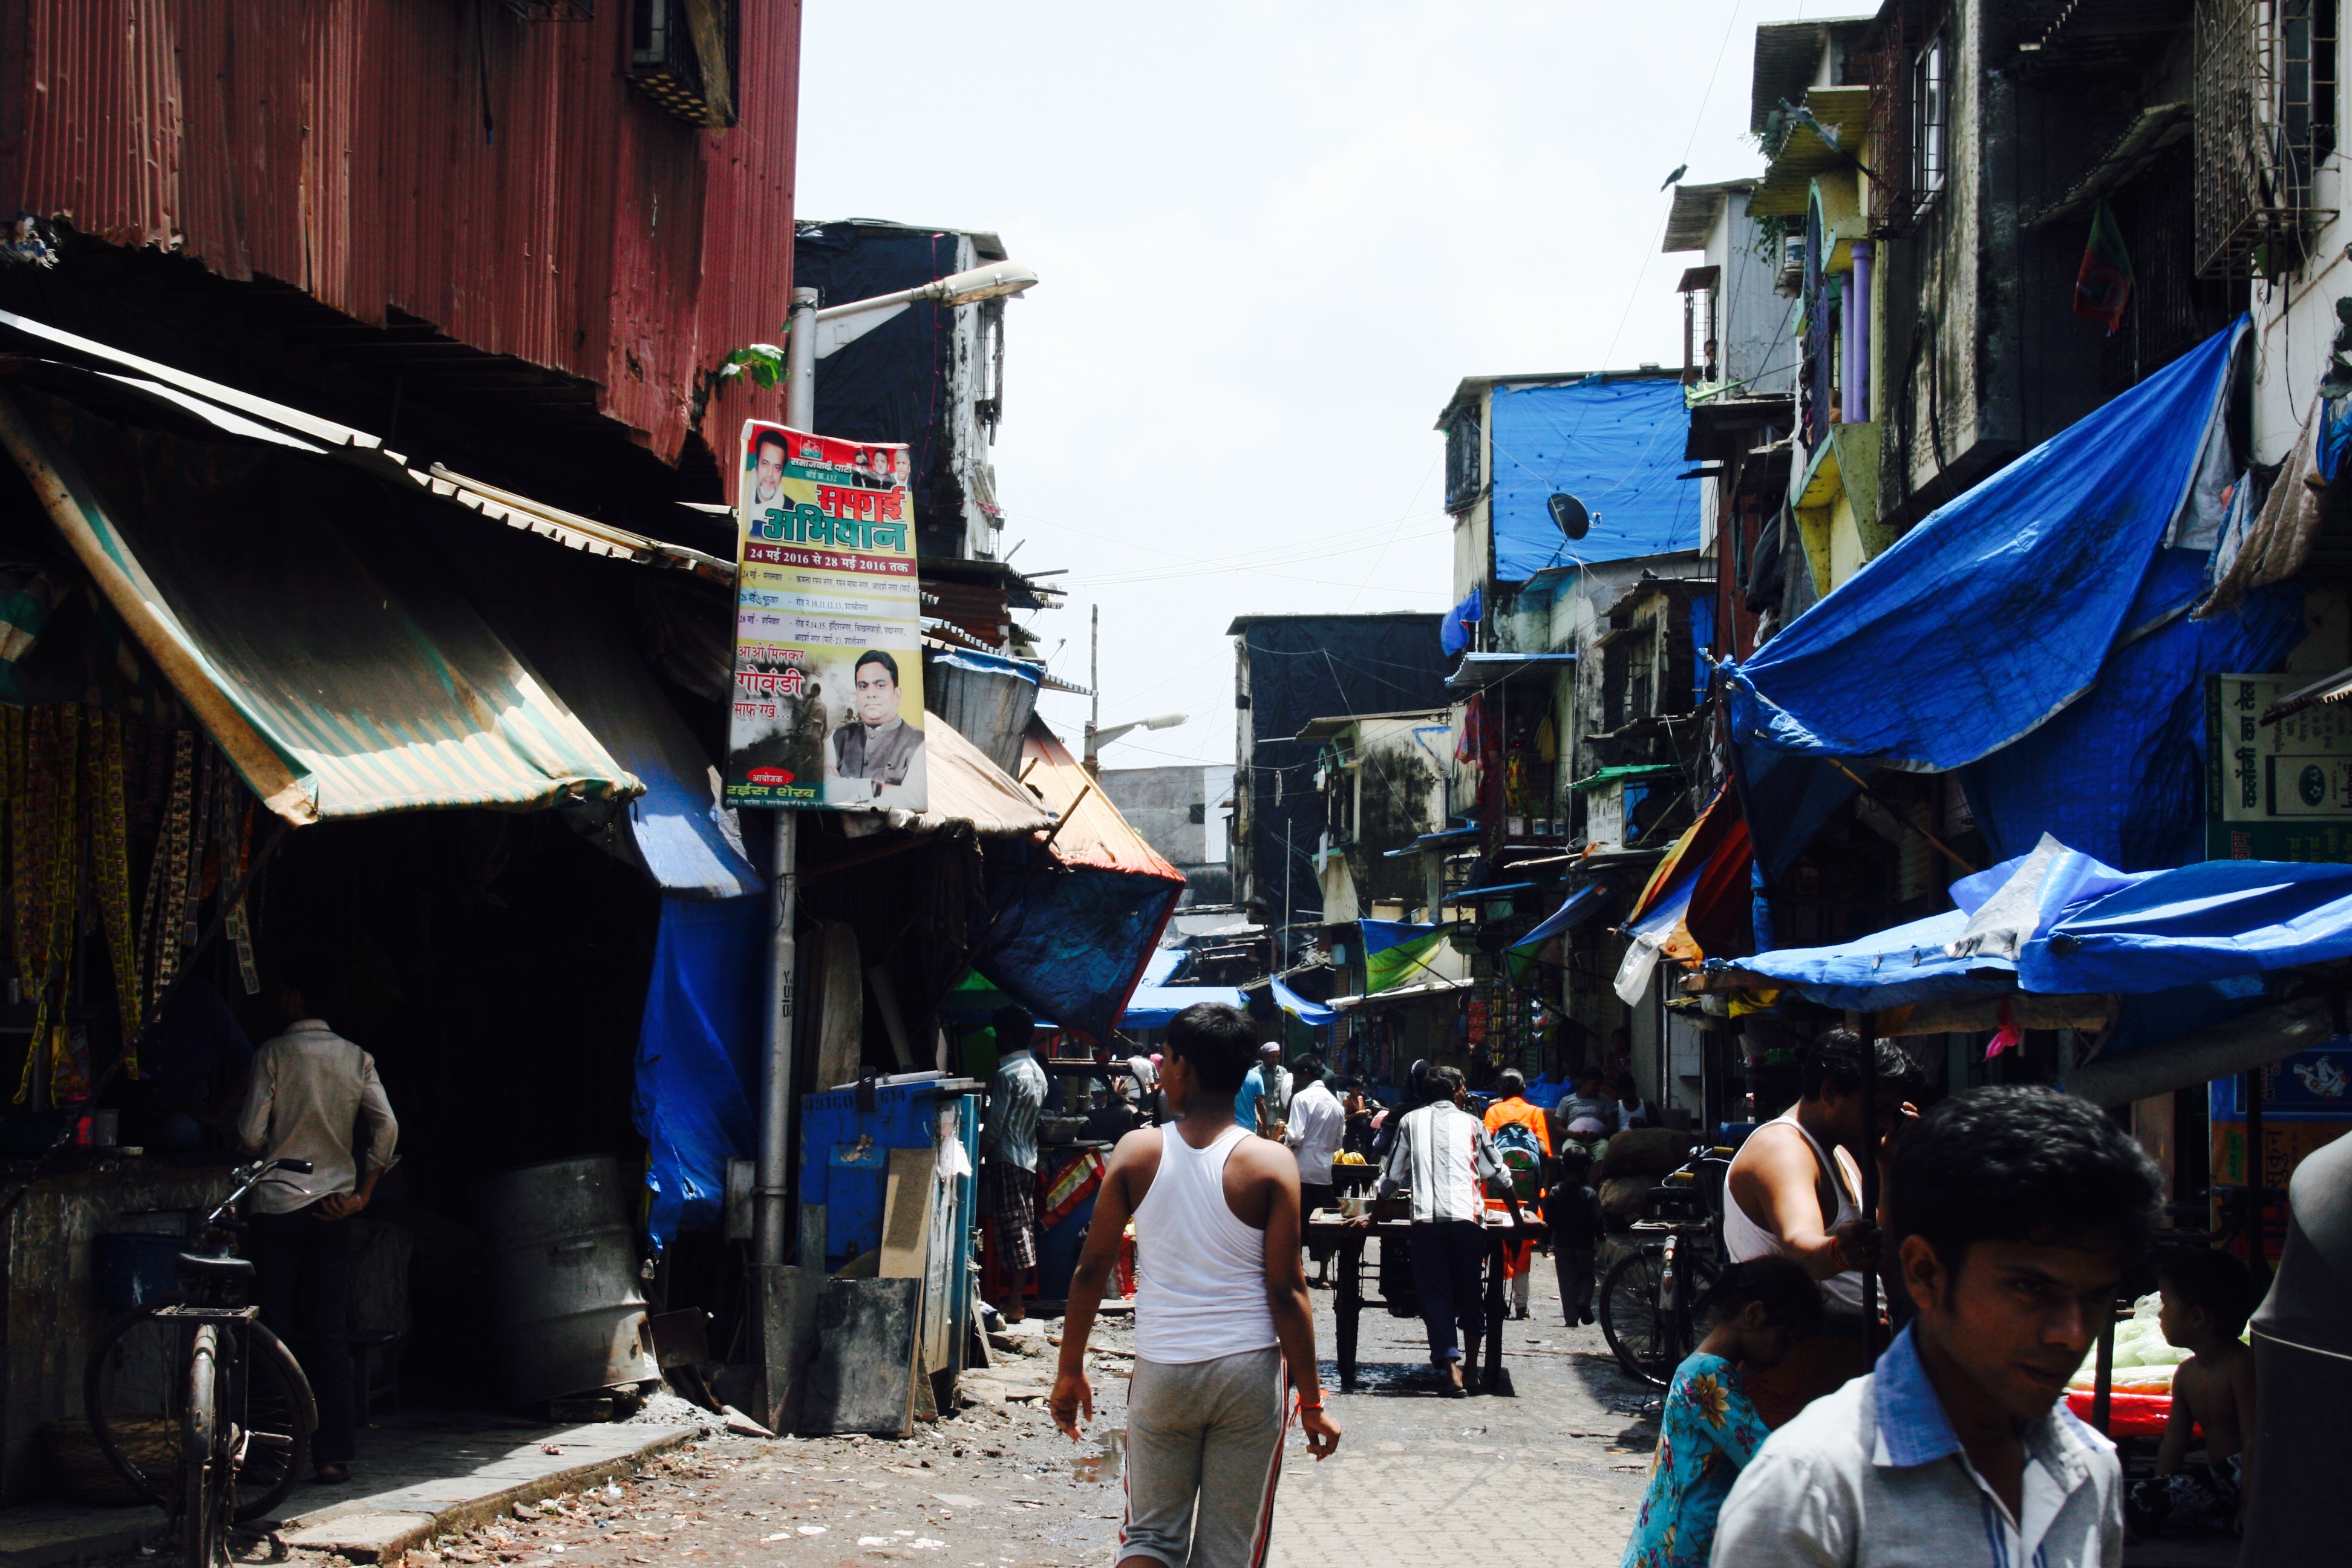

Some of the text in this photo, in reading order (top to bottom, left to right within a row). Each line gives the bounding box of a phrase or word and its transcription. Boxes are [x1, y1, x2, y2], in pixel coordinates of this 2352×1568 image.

[791, 457, 853, 473] समाजवादी पार्टी
[817, 484, 908, 523] सफाई
[762, 503, 908, 553] अभियान
[750, 548, 909, 573] 24 मई 2016 से 28 मई 2016 तक
[750, 568, 757, 580] मई
[795, 596, 805, 606] रोड
[739, 613, 780, 626] 28 मई शनिवार
[795, 617, 805, 627] रोड
[737, 643, 805, 661] आओ मिलकर
[736, 665, 803, 696] गोवंडी
[2234, 682, 2256, 711] तेल
[733, 701, 757, 719] साफ
[2241, 715, 2256, 742] का
[753, 773, 783, 783] आयोजक
[727, 782, 815, 798] रईस शेख
